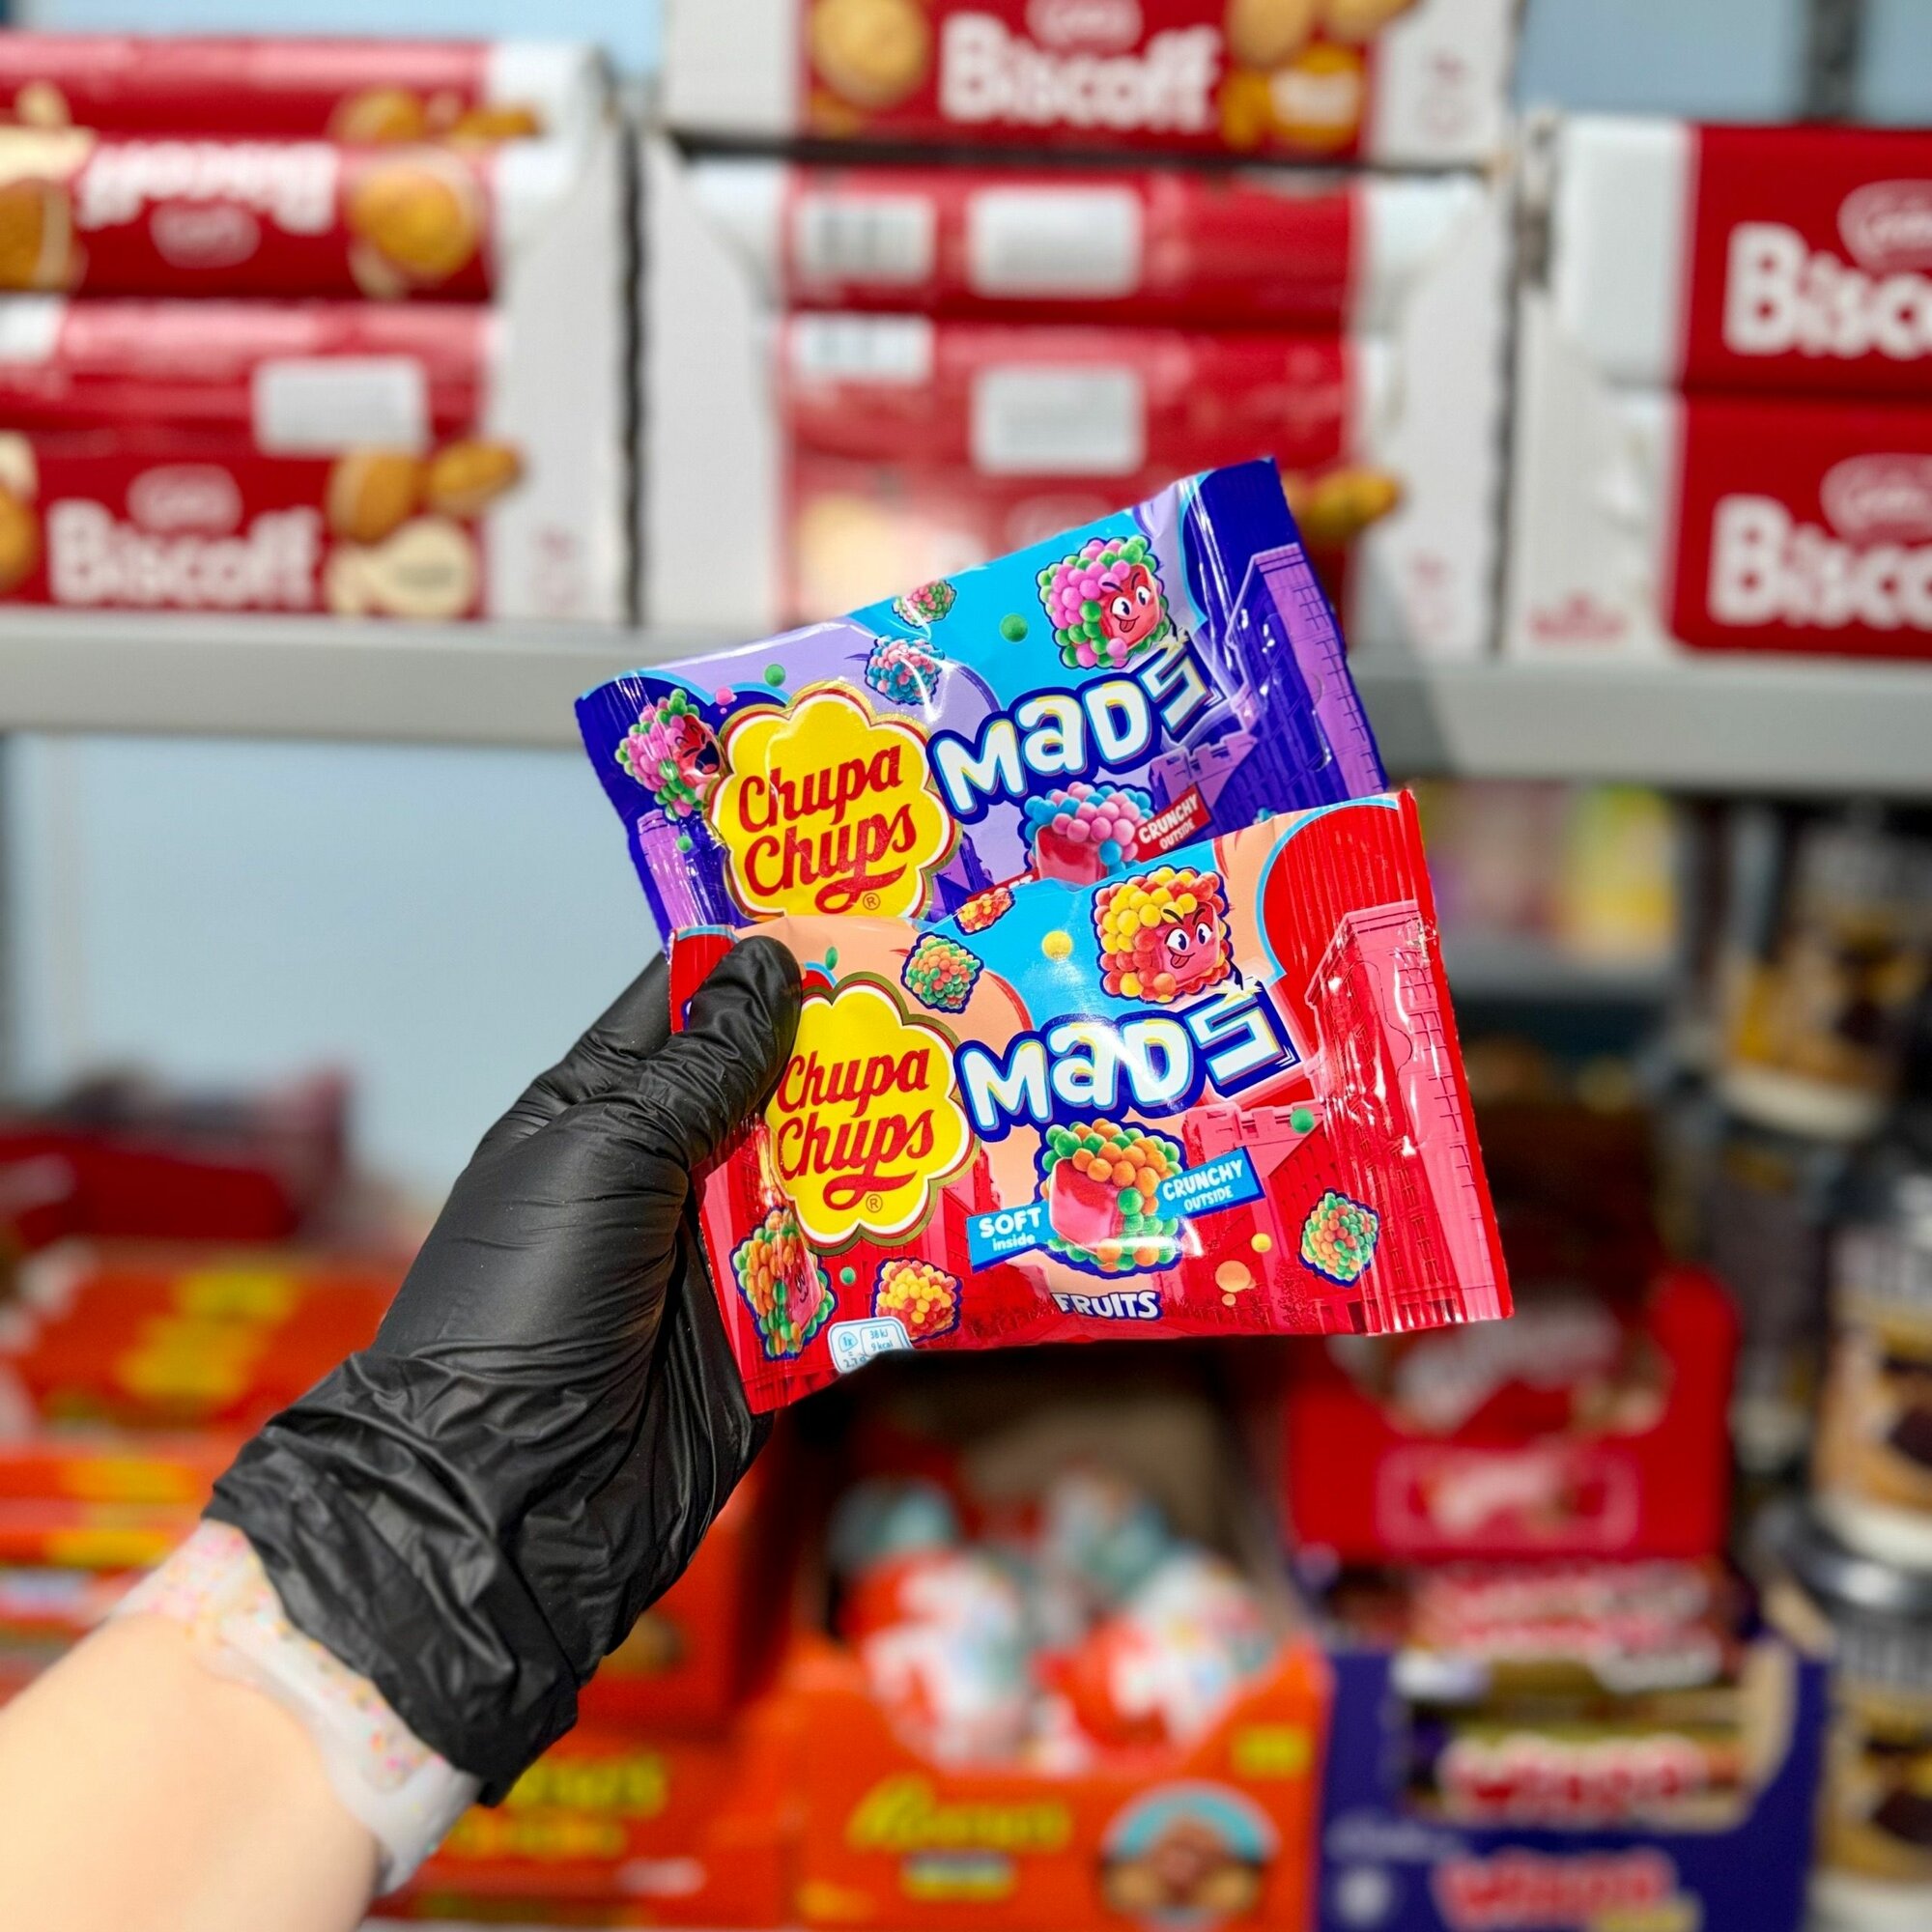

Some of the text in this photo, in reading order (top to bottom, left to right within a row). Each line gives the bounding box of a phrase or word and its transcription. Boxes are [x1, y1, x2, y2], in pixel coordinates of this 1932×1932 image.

[739, 745, 903, 833] Chupa
[1138, 792, 1199, 844] CRUNCHY
[1159, 817, 1196, 850] OUTSIDE
[744, 804, 917, 914] Chups
[777, 1048, 930, 1118] Chupa
[778, 1109, 935, 1210] Chups
[1162, 1159, 1243, 1201] CRUNCHY
[1183, 1185, 1234, 1212] OUTSIDE
[979, 1207, 1041, 1239] SOFT
[993, 1233, 1036, 1252] inside
[1052, 1292, 1159, 1319] FRUITS
[878, 1341, 894, 1350] kcal
